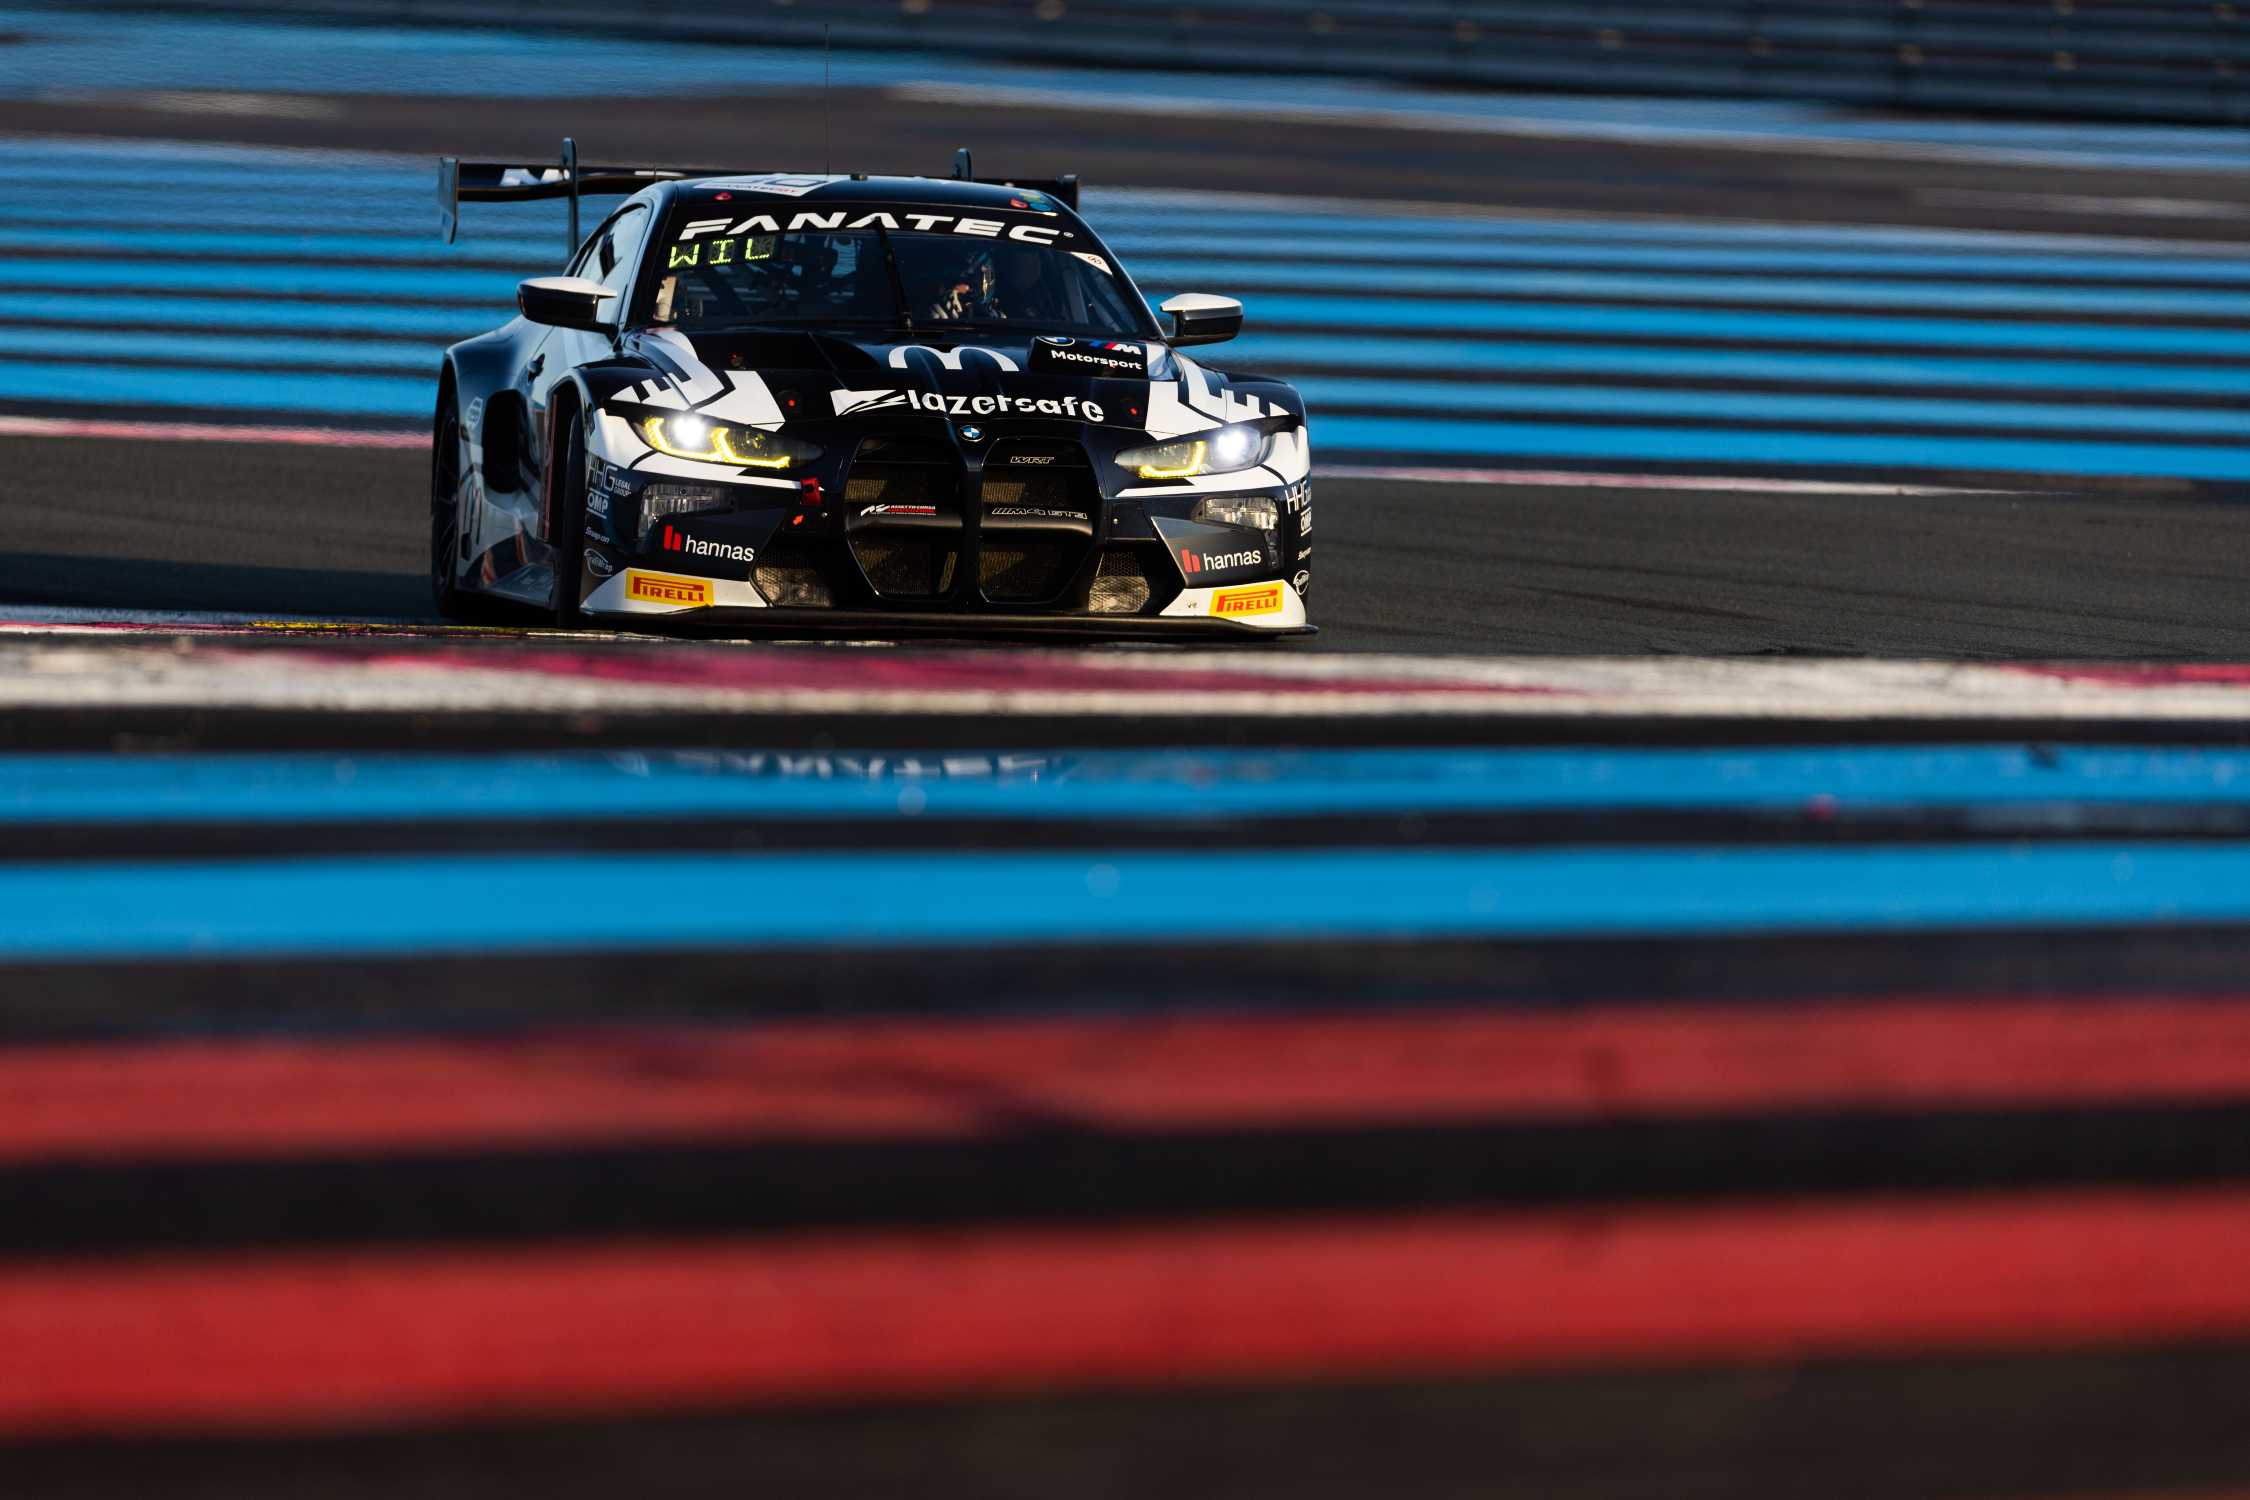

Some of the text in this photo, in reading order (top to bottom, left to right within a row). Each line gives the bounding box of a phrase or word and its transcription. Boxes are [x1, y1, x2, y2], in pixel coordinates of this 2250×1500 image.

[679, 212, 1060, 245] FANATEC
[668, 237, 770, 269] WIL
[1050, 349, 1143, 370] Motorsport
[906, 389, 1105, 423] lazersafe
[1010, 455, 1055, 465] WRT
[686, 534, 755, 562] hannas
[1203, 550, 1262, 572] hannas
[633, 576, 704, 602] PIRELLI
[1216, 589, 1278, 613] PIRELLI
